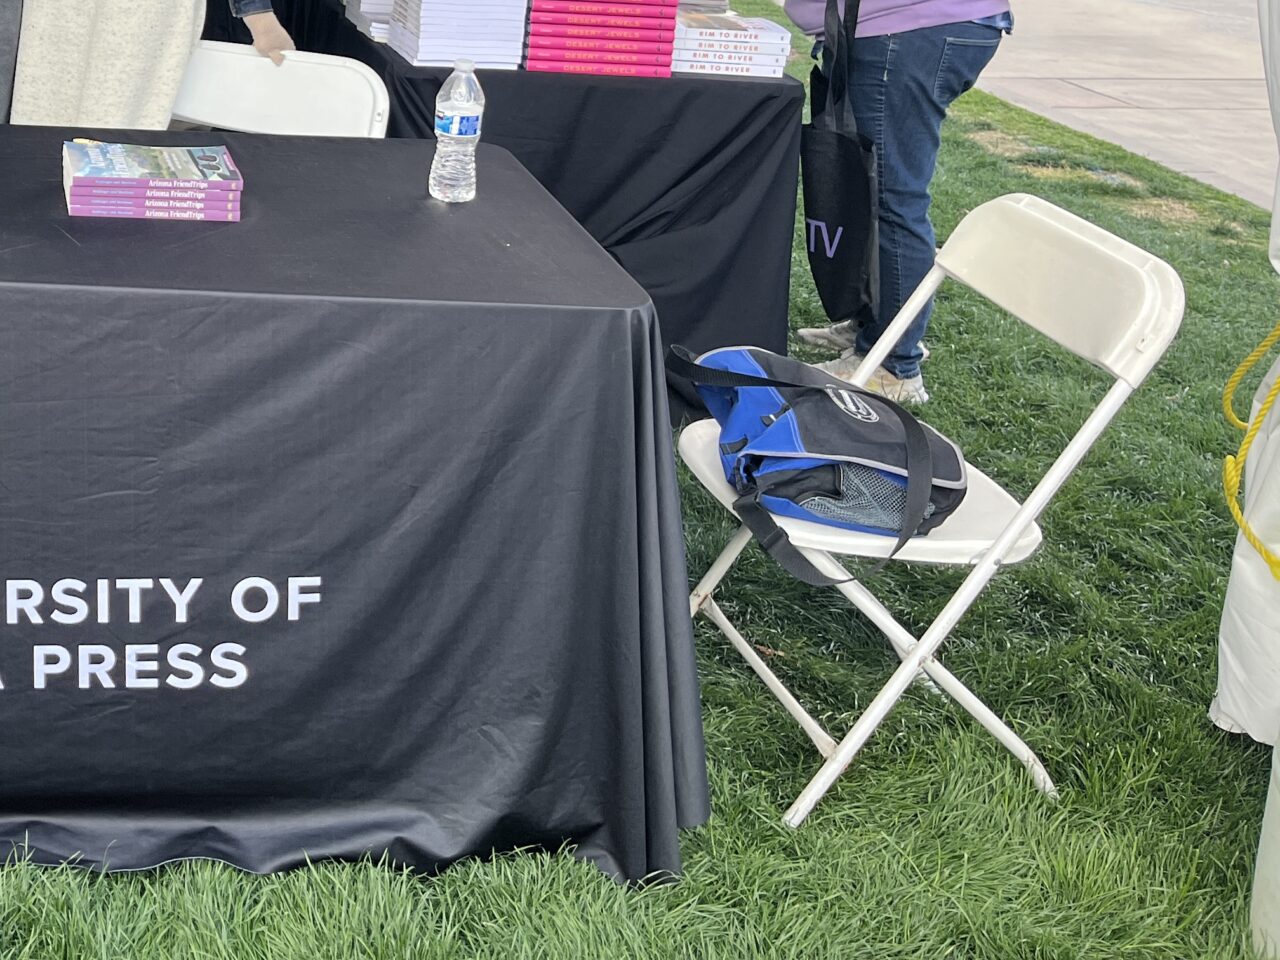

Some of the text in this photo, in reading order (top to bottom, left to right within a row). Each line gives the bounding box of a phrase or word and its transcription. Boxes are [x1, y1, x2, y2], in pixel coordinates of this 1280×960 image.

[570, 4, 641, 14] DESERT JEWELS
[567, 17, 640, 26] DESERT JEWELS
[567, 28, 640, 38] DESERT JEWELS
[734, 32, 759, 40] RIVER
[566, 40, 638, 50] DESERT JEWELS
[734, 44, 759, 52] RIVER
[564, 52, 638, 62] DESERT JEWELS
[728, 54, 753, 62] RIVER
[563, 64, 636, 74] DESERT JEWELS
[148, 179, 208, 189] Arizona FriendTrips
[146, 189, 205, 199] Arizona FriendTrips
[145, 199, 204, 209] Arizona FriendTrips
[145, 209, 205, 219] Arizona FriendTrips
[230, 576, 322, 623] OF
[33, 642, 248, 689] PRESS
